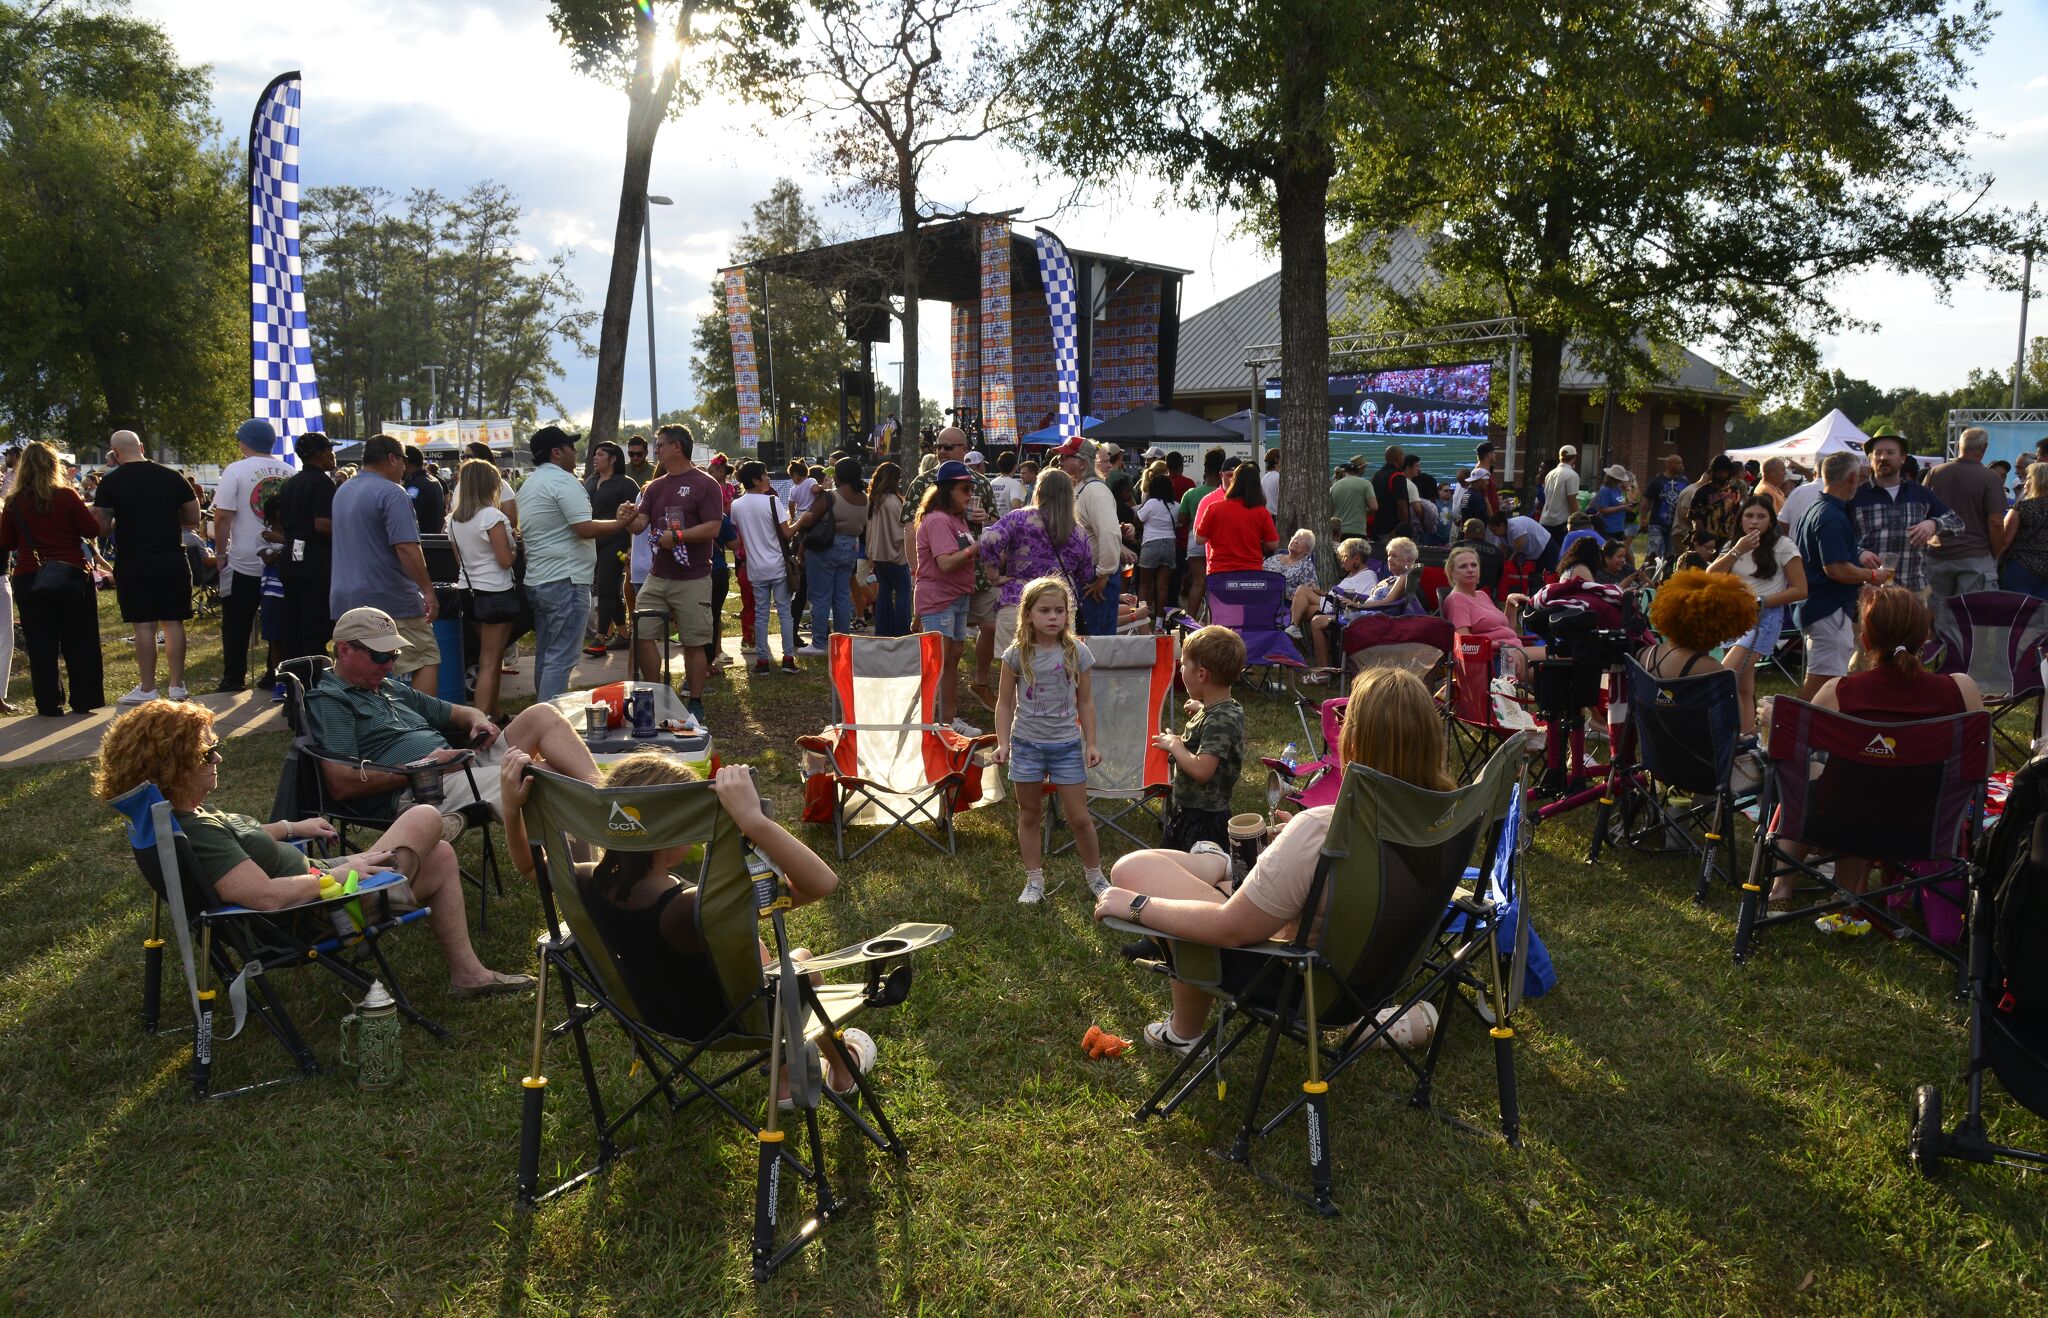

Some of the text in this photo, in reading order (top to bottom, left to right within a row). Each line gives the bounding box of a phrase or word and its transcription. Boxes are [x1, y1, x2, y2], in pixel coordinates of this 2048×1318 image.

[608, 822, 638, 831] GCI
[203, 1017, 211, 1058] ROCKER
[767, 1182, 775, 1218] COMFORT
